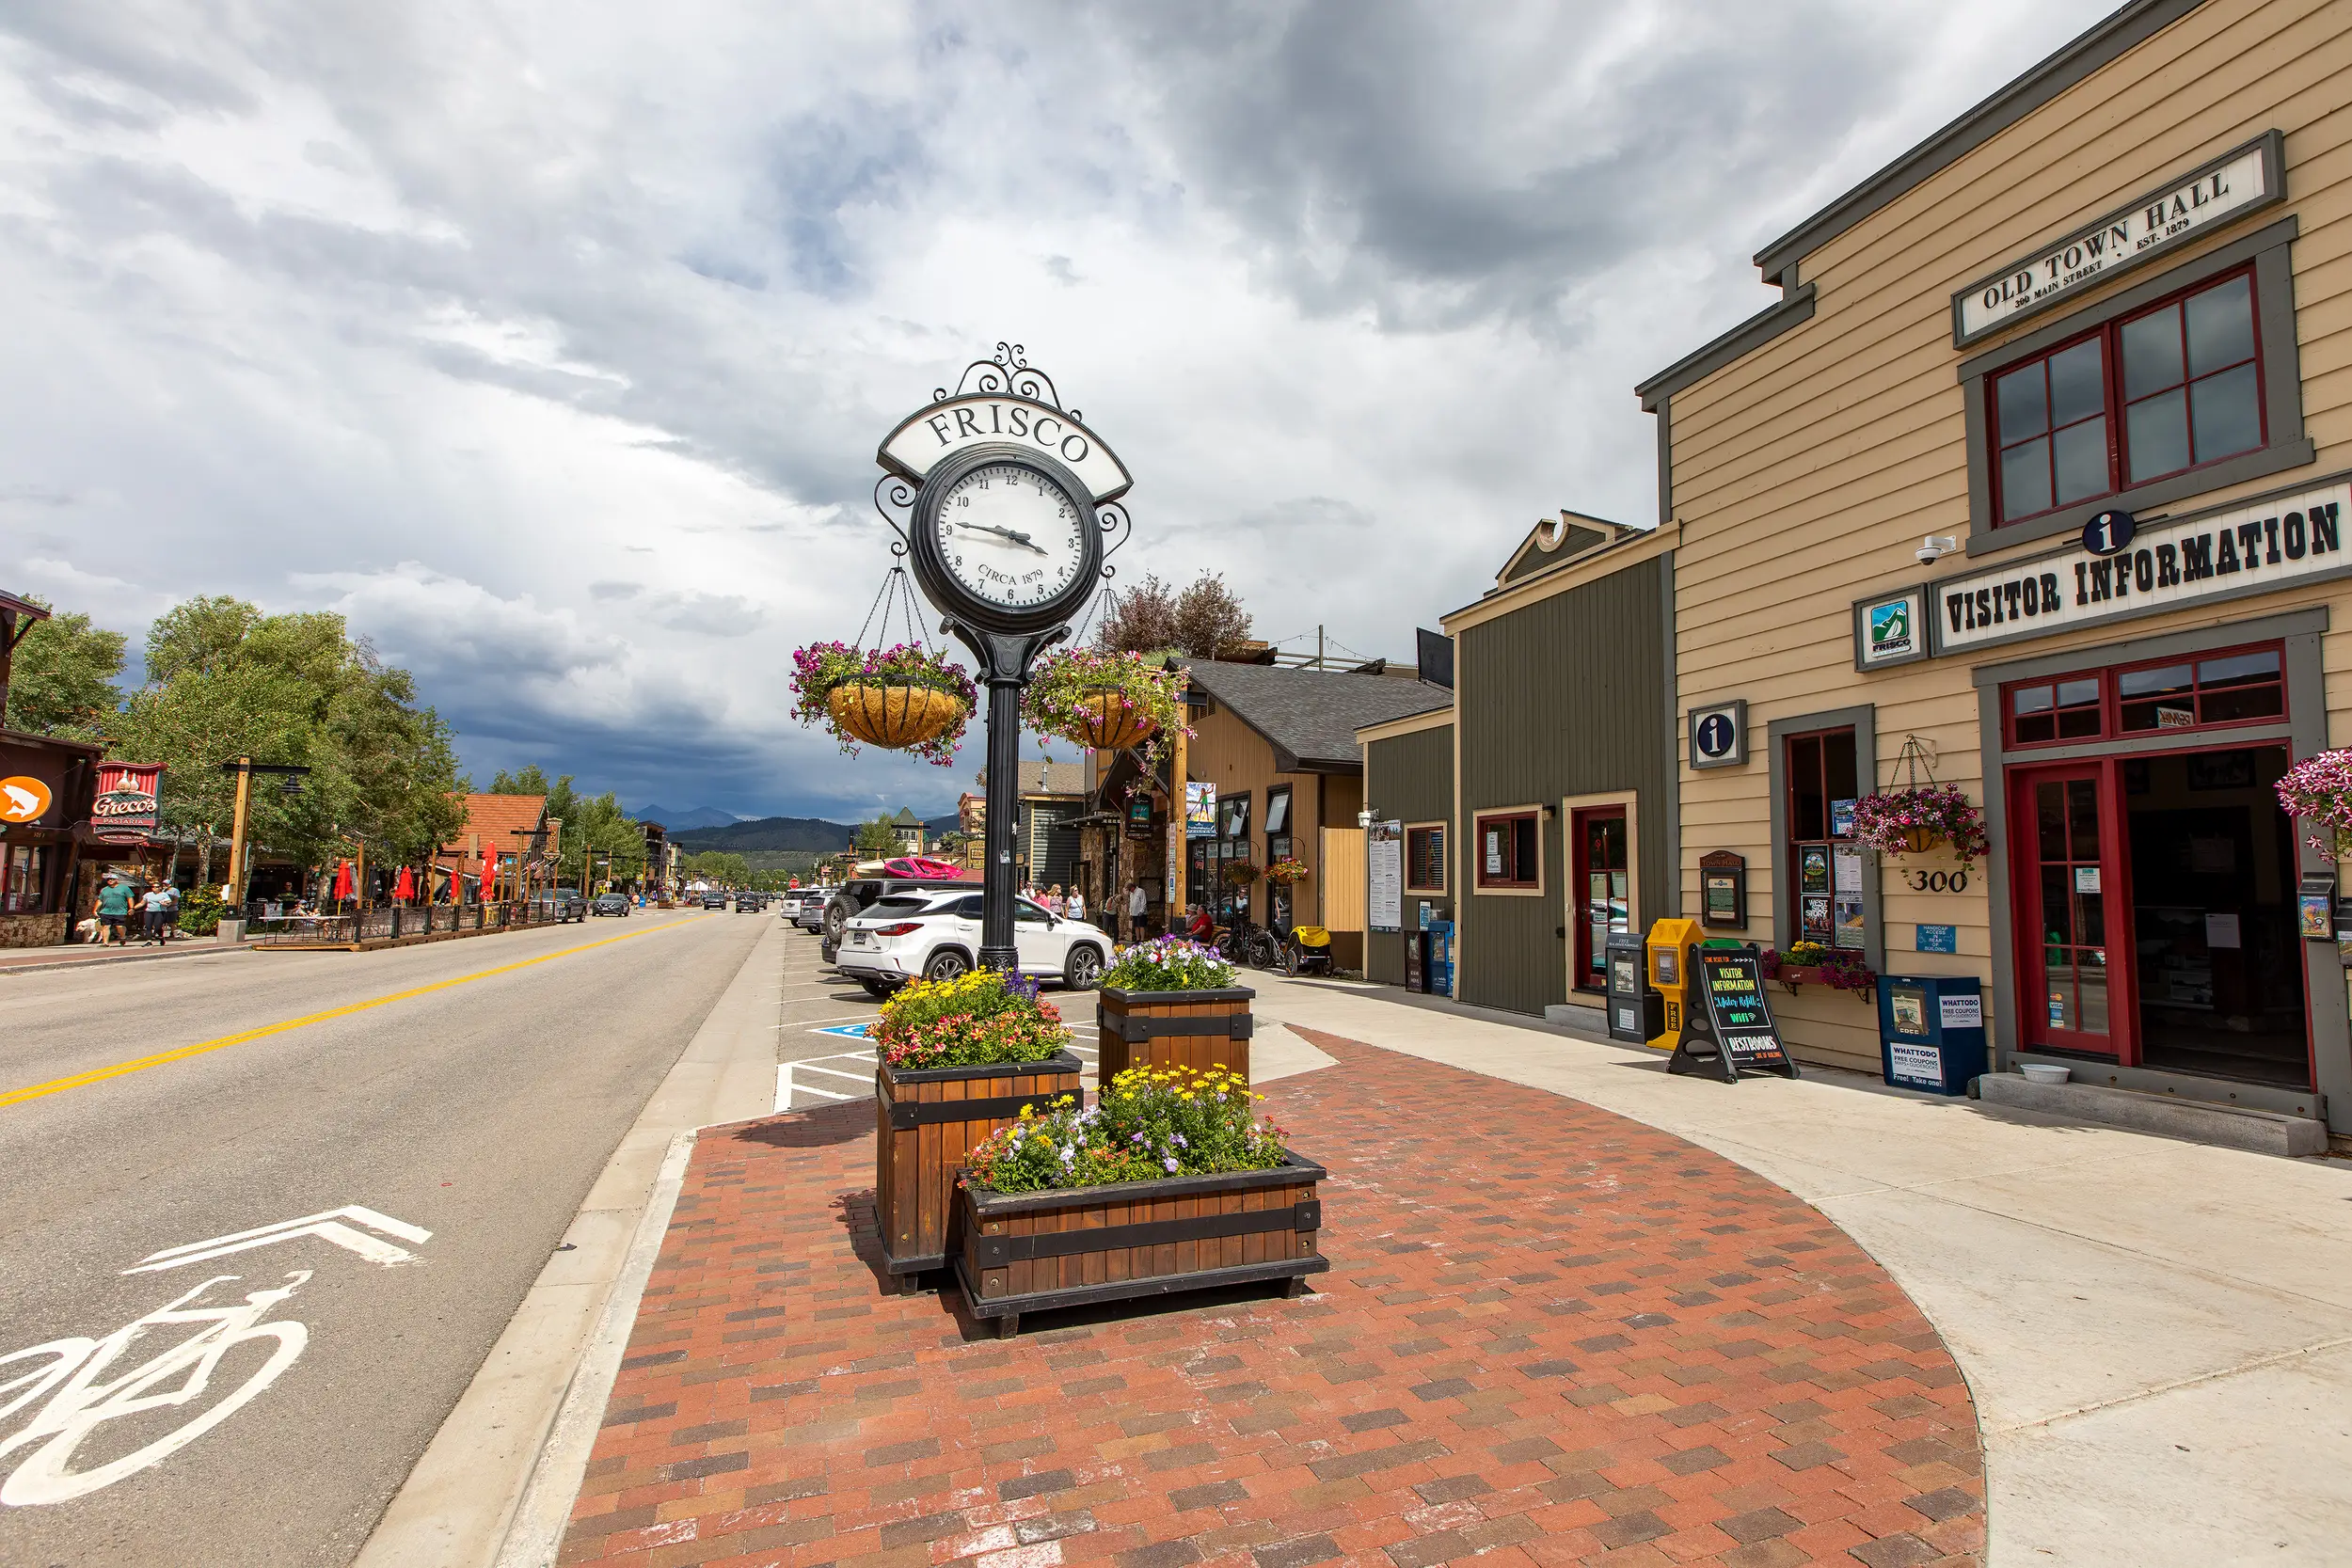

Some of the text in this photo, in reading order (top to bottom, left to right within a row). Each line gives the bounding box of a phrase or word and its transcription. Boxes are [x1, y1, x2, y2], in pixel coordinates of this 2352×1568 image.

[2137, 218, 2189, 250] EST. 1879
[1983, 173, 2229, 309] OLD TOWN HALL
[2014, 260, 2103, 309] 300 MAIN STREET
[925, 404, 1089, 463] FRISCO
[978, 479, 990, 490] 11
[1006, 475, 1019, 486] 12
[1038, 485, 1044, 497] 1
[957, 496, 969, 508] 10
[1058, 508, 1066, 519] 2
[946, 525, 953, 536] 9
[1068, 537, 1075, 549] 3
[955, 556, 962, 566] 8
[1946, 501, 2339, 633] VISITOR INFORMATION
[977, 563, 1043, 586] CIRCA 1879
[1057, 565, 1064, 577] 4
[978, 578, 985, 590] 7
[1037, 584, 1044, 594] 5
[1007, 589, 1014, 600] 6
[1872, 639, 1911, 652] FRISCO
[93, 797, 157, 816] Greco's
[1913, 870, 1968, 893] 300
[1808, 899, 1828, 908] WEST
[1804, 910, 1827, 918] STORY
[1719, 968, 1743, 978] VISITOR
[1712, 980, 1755, 991] INFORMATION
[1728, 1036, 1777, 1052] RESTROOMS
[1893, 1046, 1937, 1058] WHATTODO
[1909, 1056, 1938, 1066] COUPONS
[1893, 1073, 1909, 1082] Free!
[1913, 1076, 1927, 1085] Take
